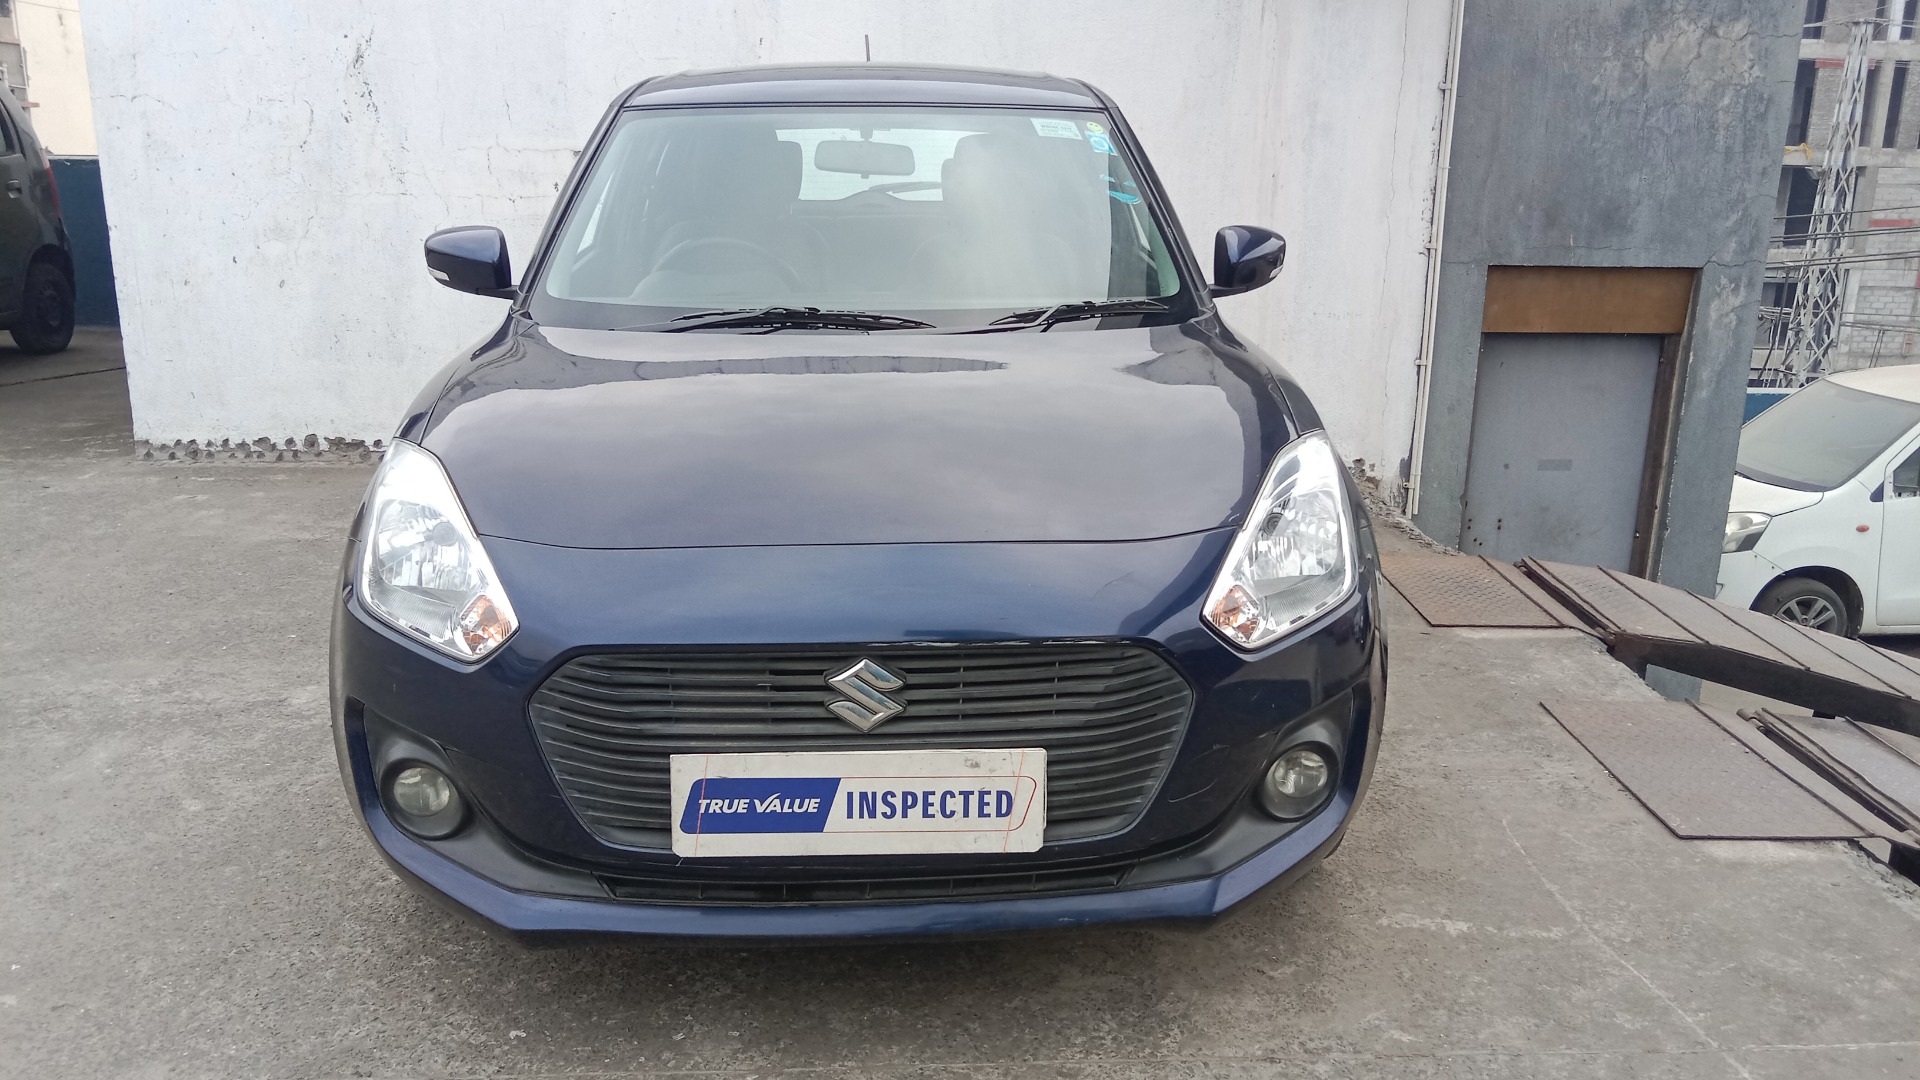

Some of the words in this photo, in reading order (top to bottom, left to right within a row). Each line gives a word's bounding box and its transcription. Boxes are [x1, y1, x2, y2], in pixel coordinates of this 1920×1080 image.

[699, 798, 749, 814] TRUE
[754, 793, 821, 814] VALUE
[846, 790, 1014, 819] INSPECTED
